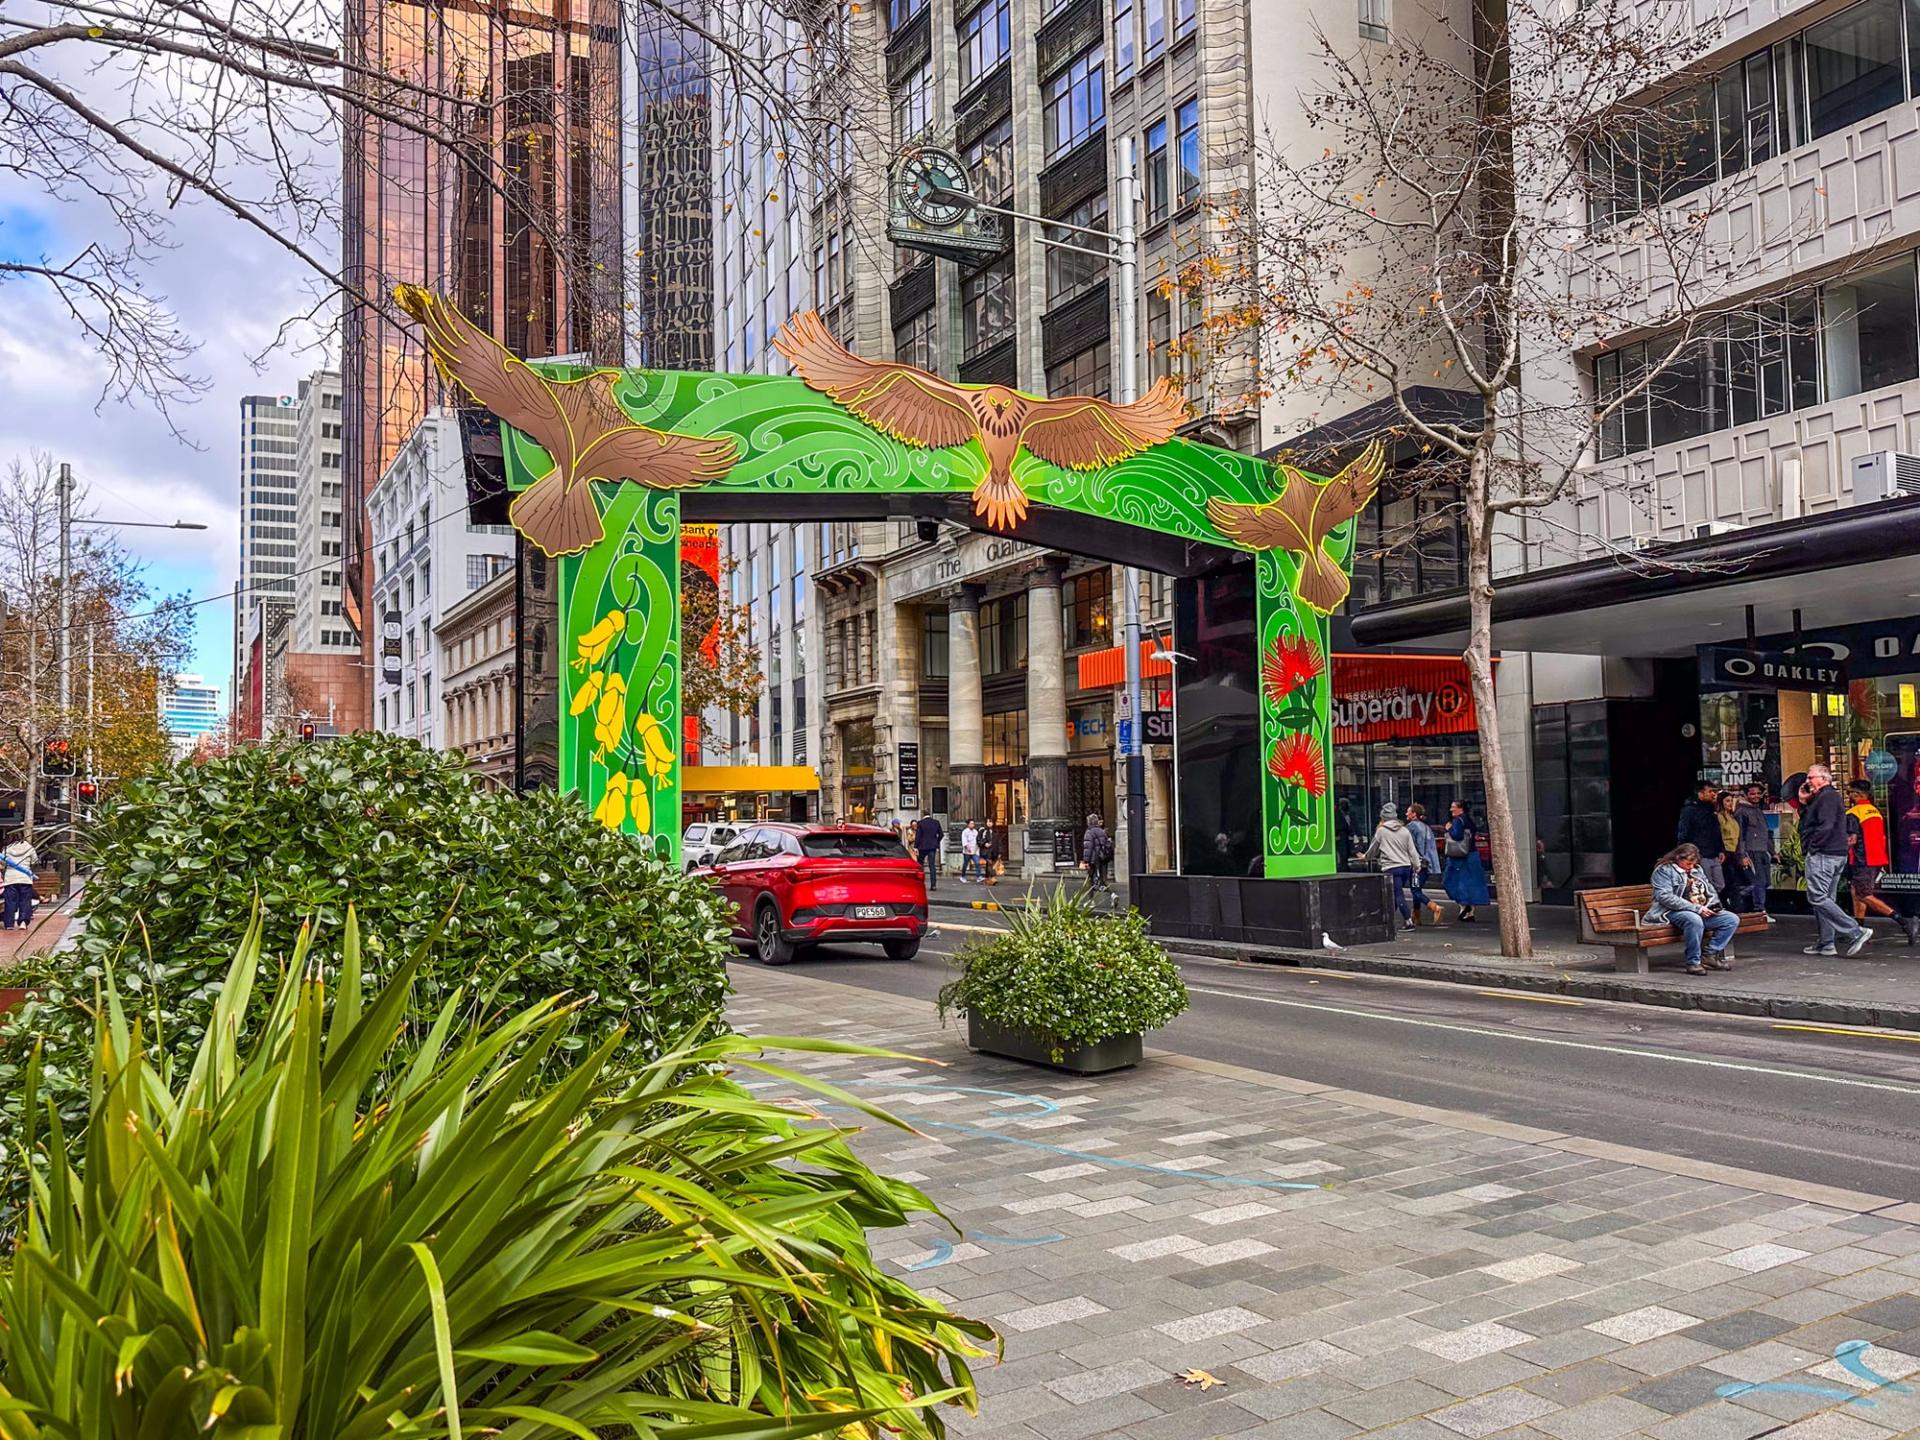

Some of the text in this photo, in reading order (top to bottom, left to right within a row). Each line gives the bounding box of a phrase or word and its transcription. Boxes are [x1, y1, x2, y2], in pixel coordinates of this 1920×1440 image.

[938, 559, 961, 579] The
[1763, 663, 1838, 683] OAKLEY
[1332, 687, 1433, 733] Superdry
[1720, 749, 1767, 762] DRAW
[1720, 761, 1763, 774] YOUR
